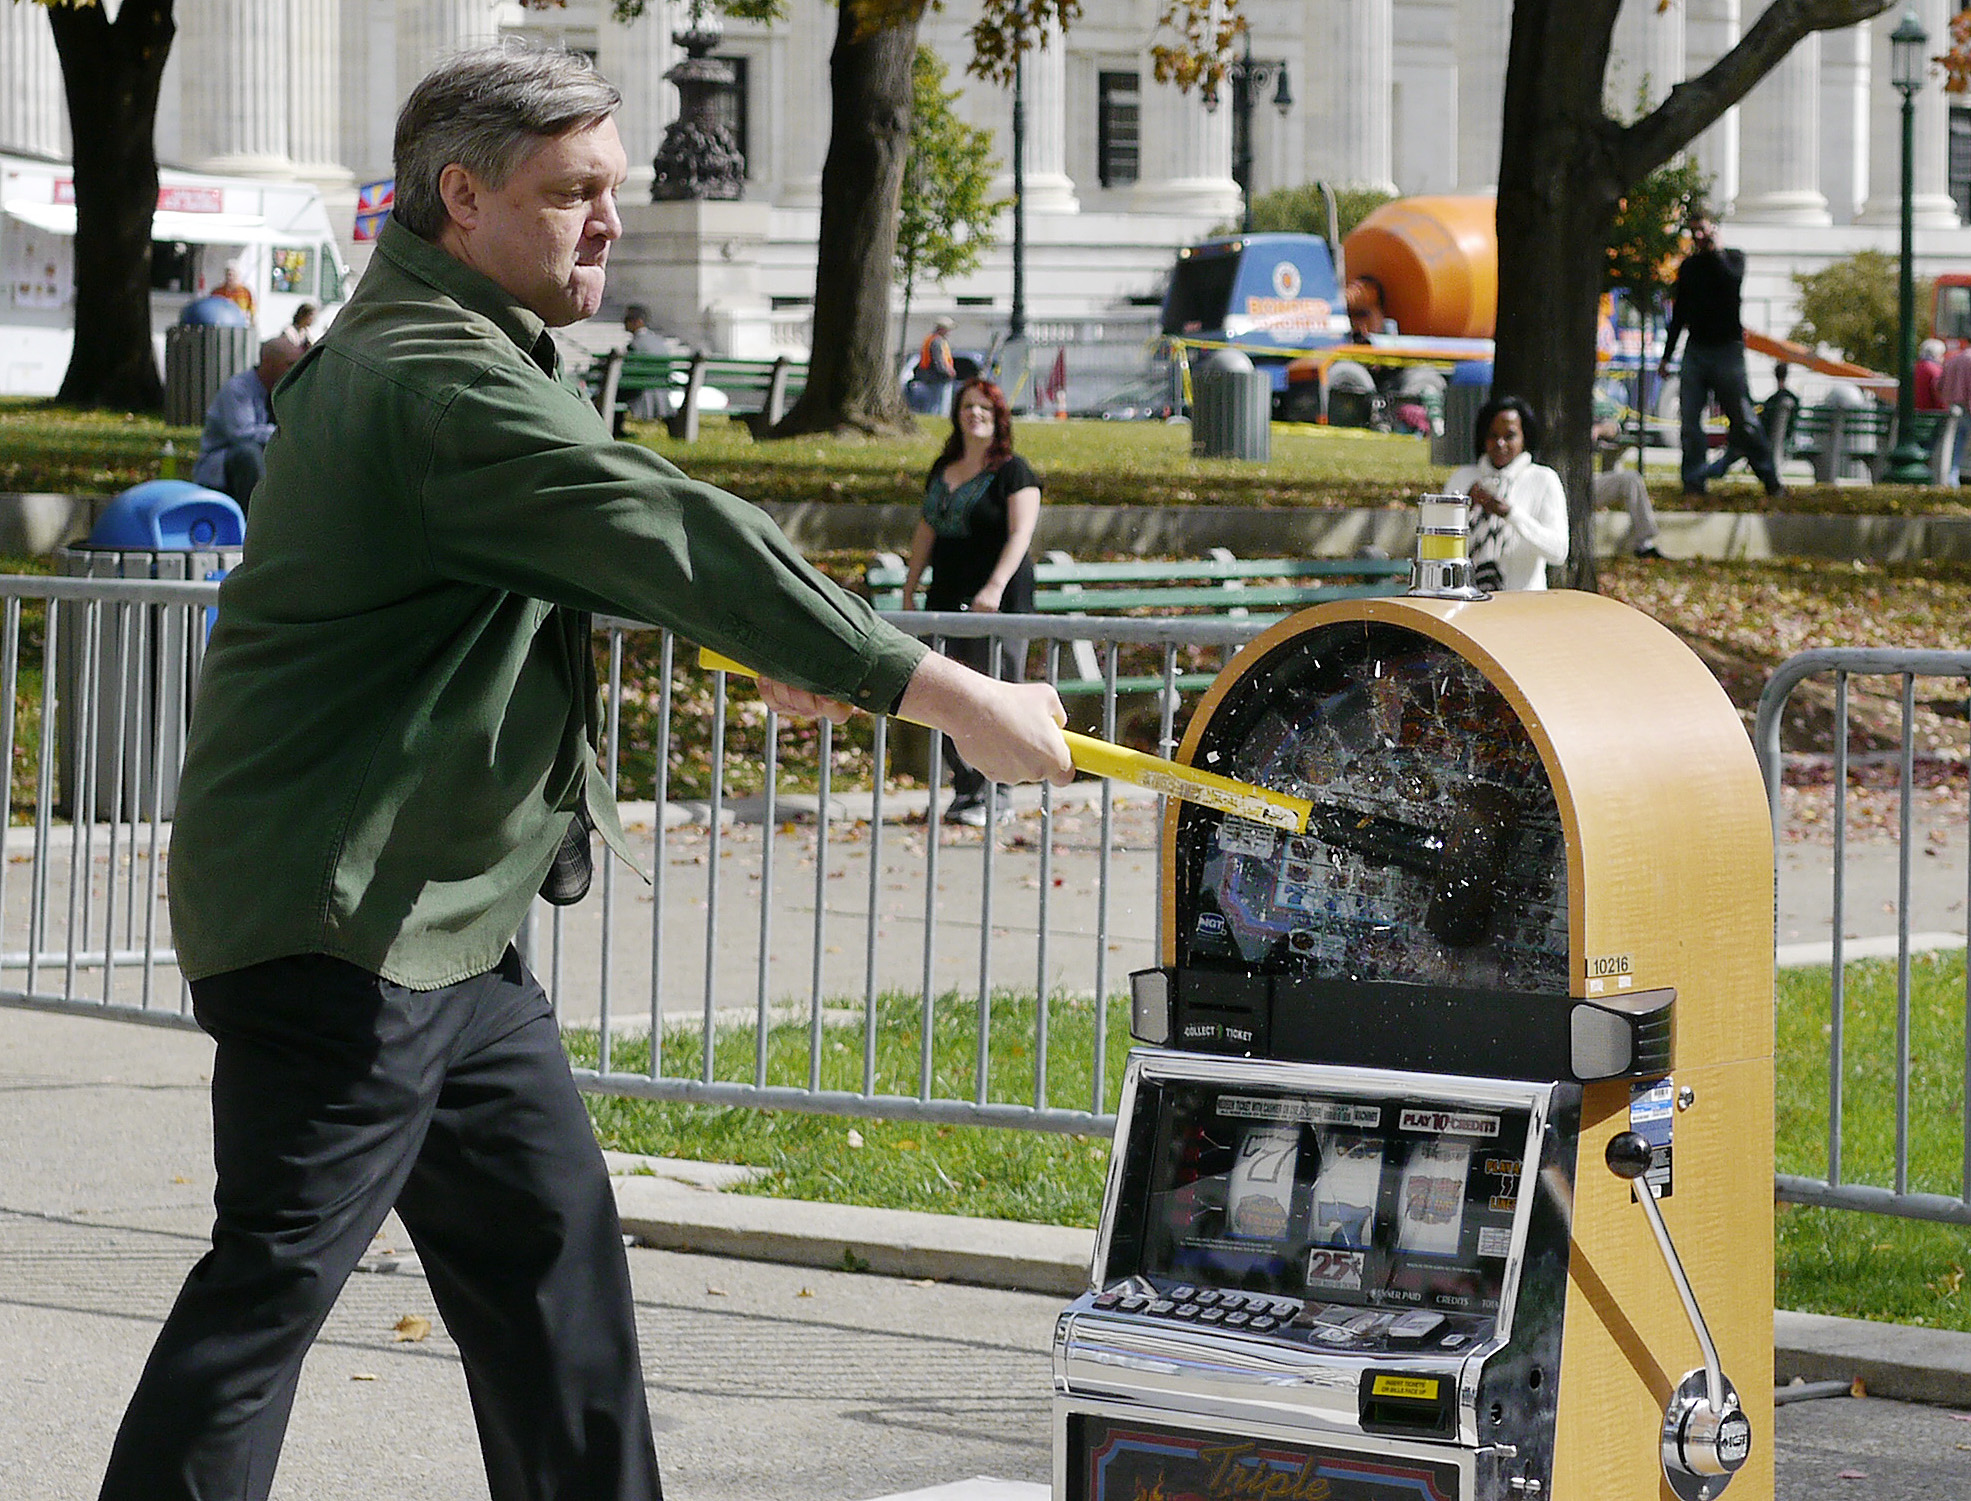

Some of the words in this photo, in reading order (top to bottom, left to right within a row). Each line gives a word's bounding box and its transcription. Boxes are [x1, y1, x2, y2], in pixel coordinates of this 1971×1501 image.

[1594, 956, 1629, 975] 10216
[1184, 1025, 1216, 1037] COLLECT
[1225, 1027, 1253, 1042] TICKET
[1404, 1113, 1431, 1127] PLAY
[1432, 1113, 1450, 1131] 10
[1450, 1116, 1497, 1133] CREDITS
[1485, 1158, 1512, 1174] PLAY
[1402, 1291, 1422, 1302] PAID
[1436, 1294, 1469, 1307] CREDITS
[1200, 1440, 1332, 1501] Triple
